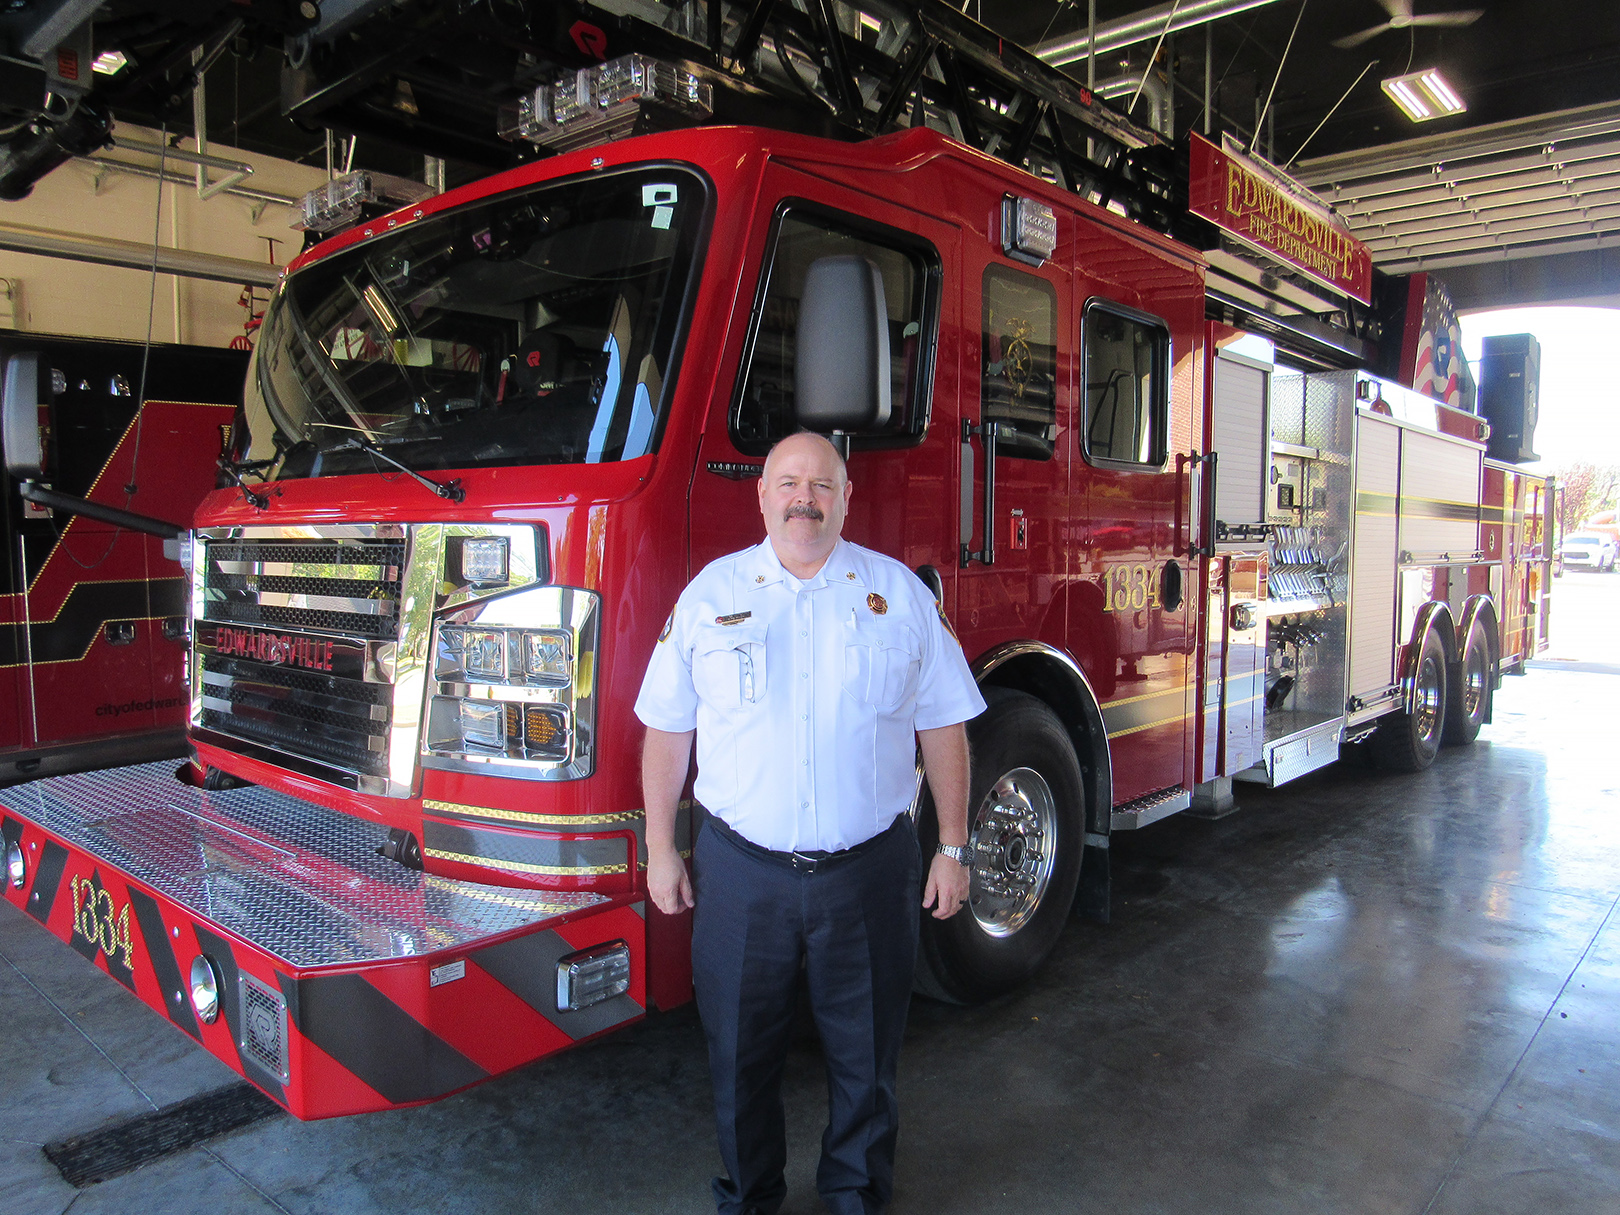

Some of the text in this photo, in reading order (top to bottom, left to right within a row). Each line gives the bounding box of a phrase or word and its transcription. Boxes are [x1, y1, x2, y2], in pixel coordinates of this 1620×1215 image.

[1080, 88, 1092, 106] 90
[1226, 161, 1354, 281] EDWARDSVILLE
[1249, 213, 1338, 281] FIRE DEPARTMENT
[1102, 563, 1161, 613] 1334
[216, 627, 333, 672] EDWARDSVILLE
[70, 873, 134, 970] 1334
